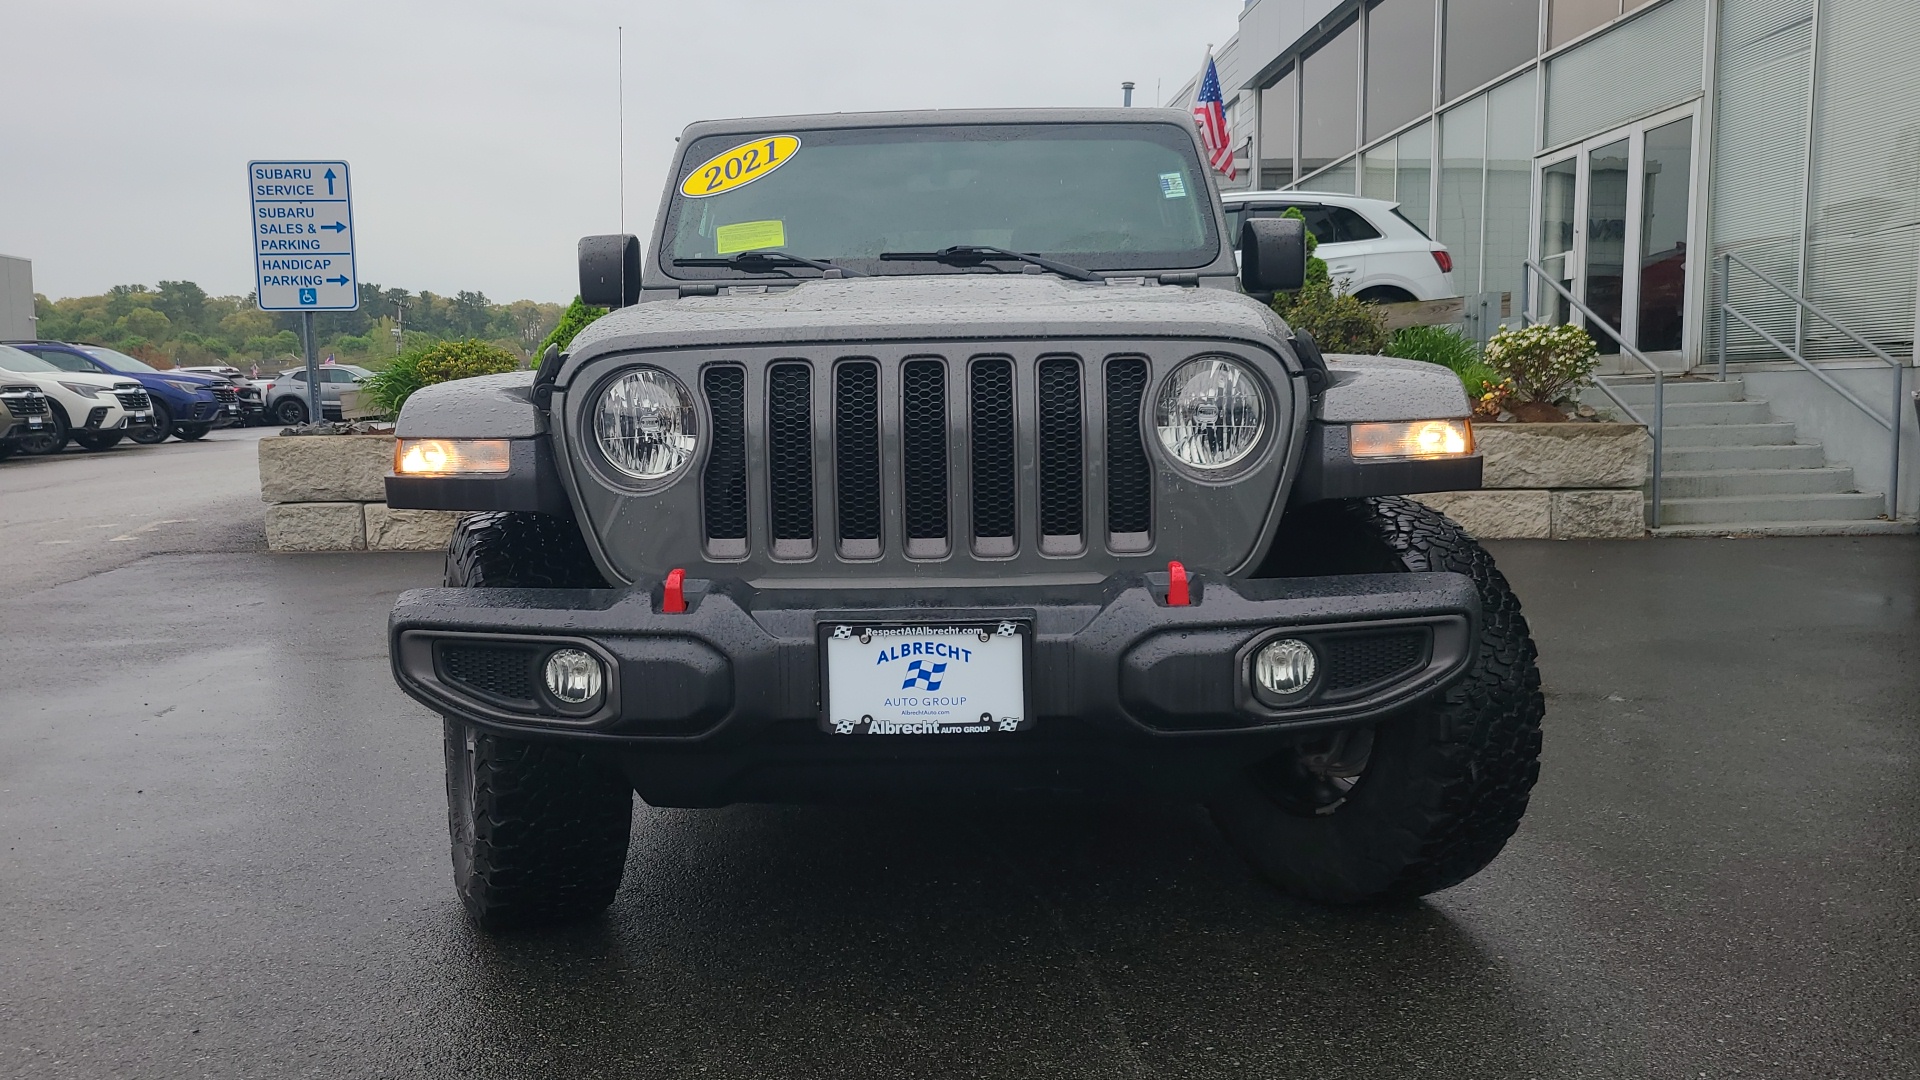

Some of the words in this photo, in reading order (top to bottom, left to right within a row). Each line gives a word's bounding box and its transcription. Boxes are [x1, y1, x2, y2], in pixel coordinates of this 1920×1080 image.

[704, 140, 779, 192] 2021
[255, 168, 312, 180] SUBARU
[257, 185, 315, 196] SERVICE
[258, 207, 315, 218] SUBARU
[260, 223, 304, 235] SALES
[307, 223, 317, 234] &
[261, 239, 321, 250] PARKING
[262, 259, 332, 270] HANDICAP
[263, 275, 323, 286] PARKING
[865, 626, 984, 637] RespectAtAlbrecht.com
[876, 641, 972, 665] ALBRECHT
[884, 697, 918, 707] AUTO
[922, 696, 967, 706] GROUP
[867, 719, 940, 735] Albrecht
[941, 726, 962, 734] AUTO
[963, 725, 991, 733] GROUP
